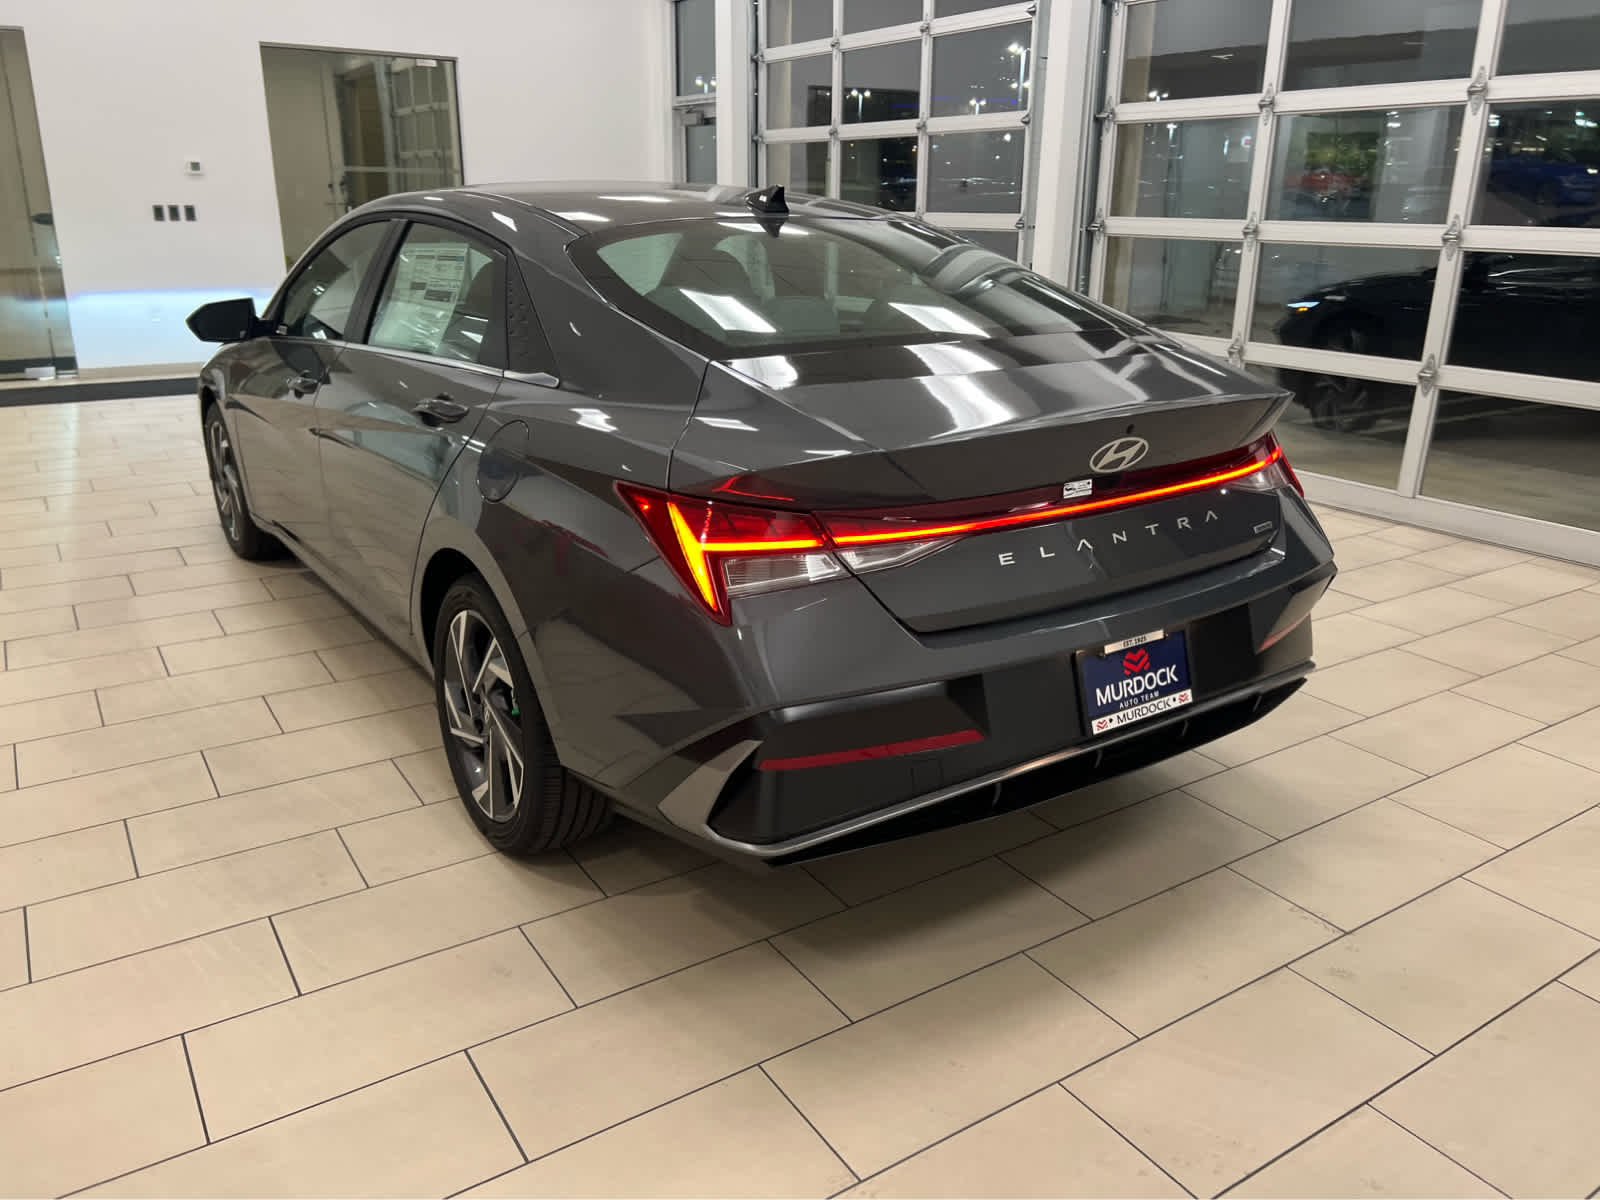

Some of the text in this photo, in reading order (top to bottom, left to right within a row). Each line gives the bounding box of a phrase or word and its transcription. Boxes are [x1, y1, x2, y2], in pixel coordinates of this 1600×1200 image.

[998, 510, 1219, 566] ELANTRA
[1095, 664, 1178, 706] MURDOCK
[1119, 690, 1160, 709] AUTO TEAM
[1116, 699, 1171, 725] MURDOCK
